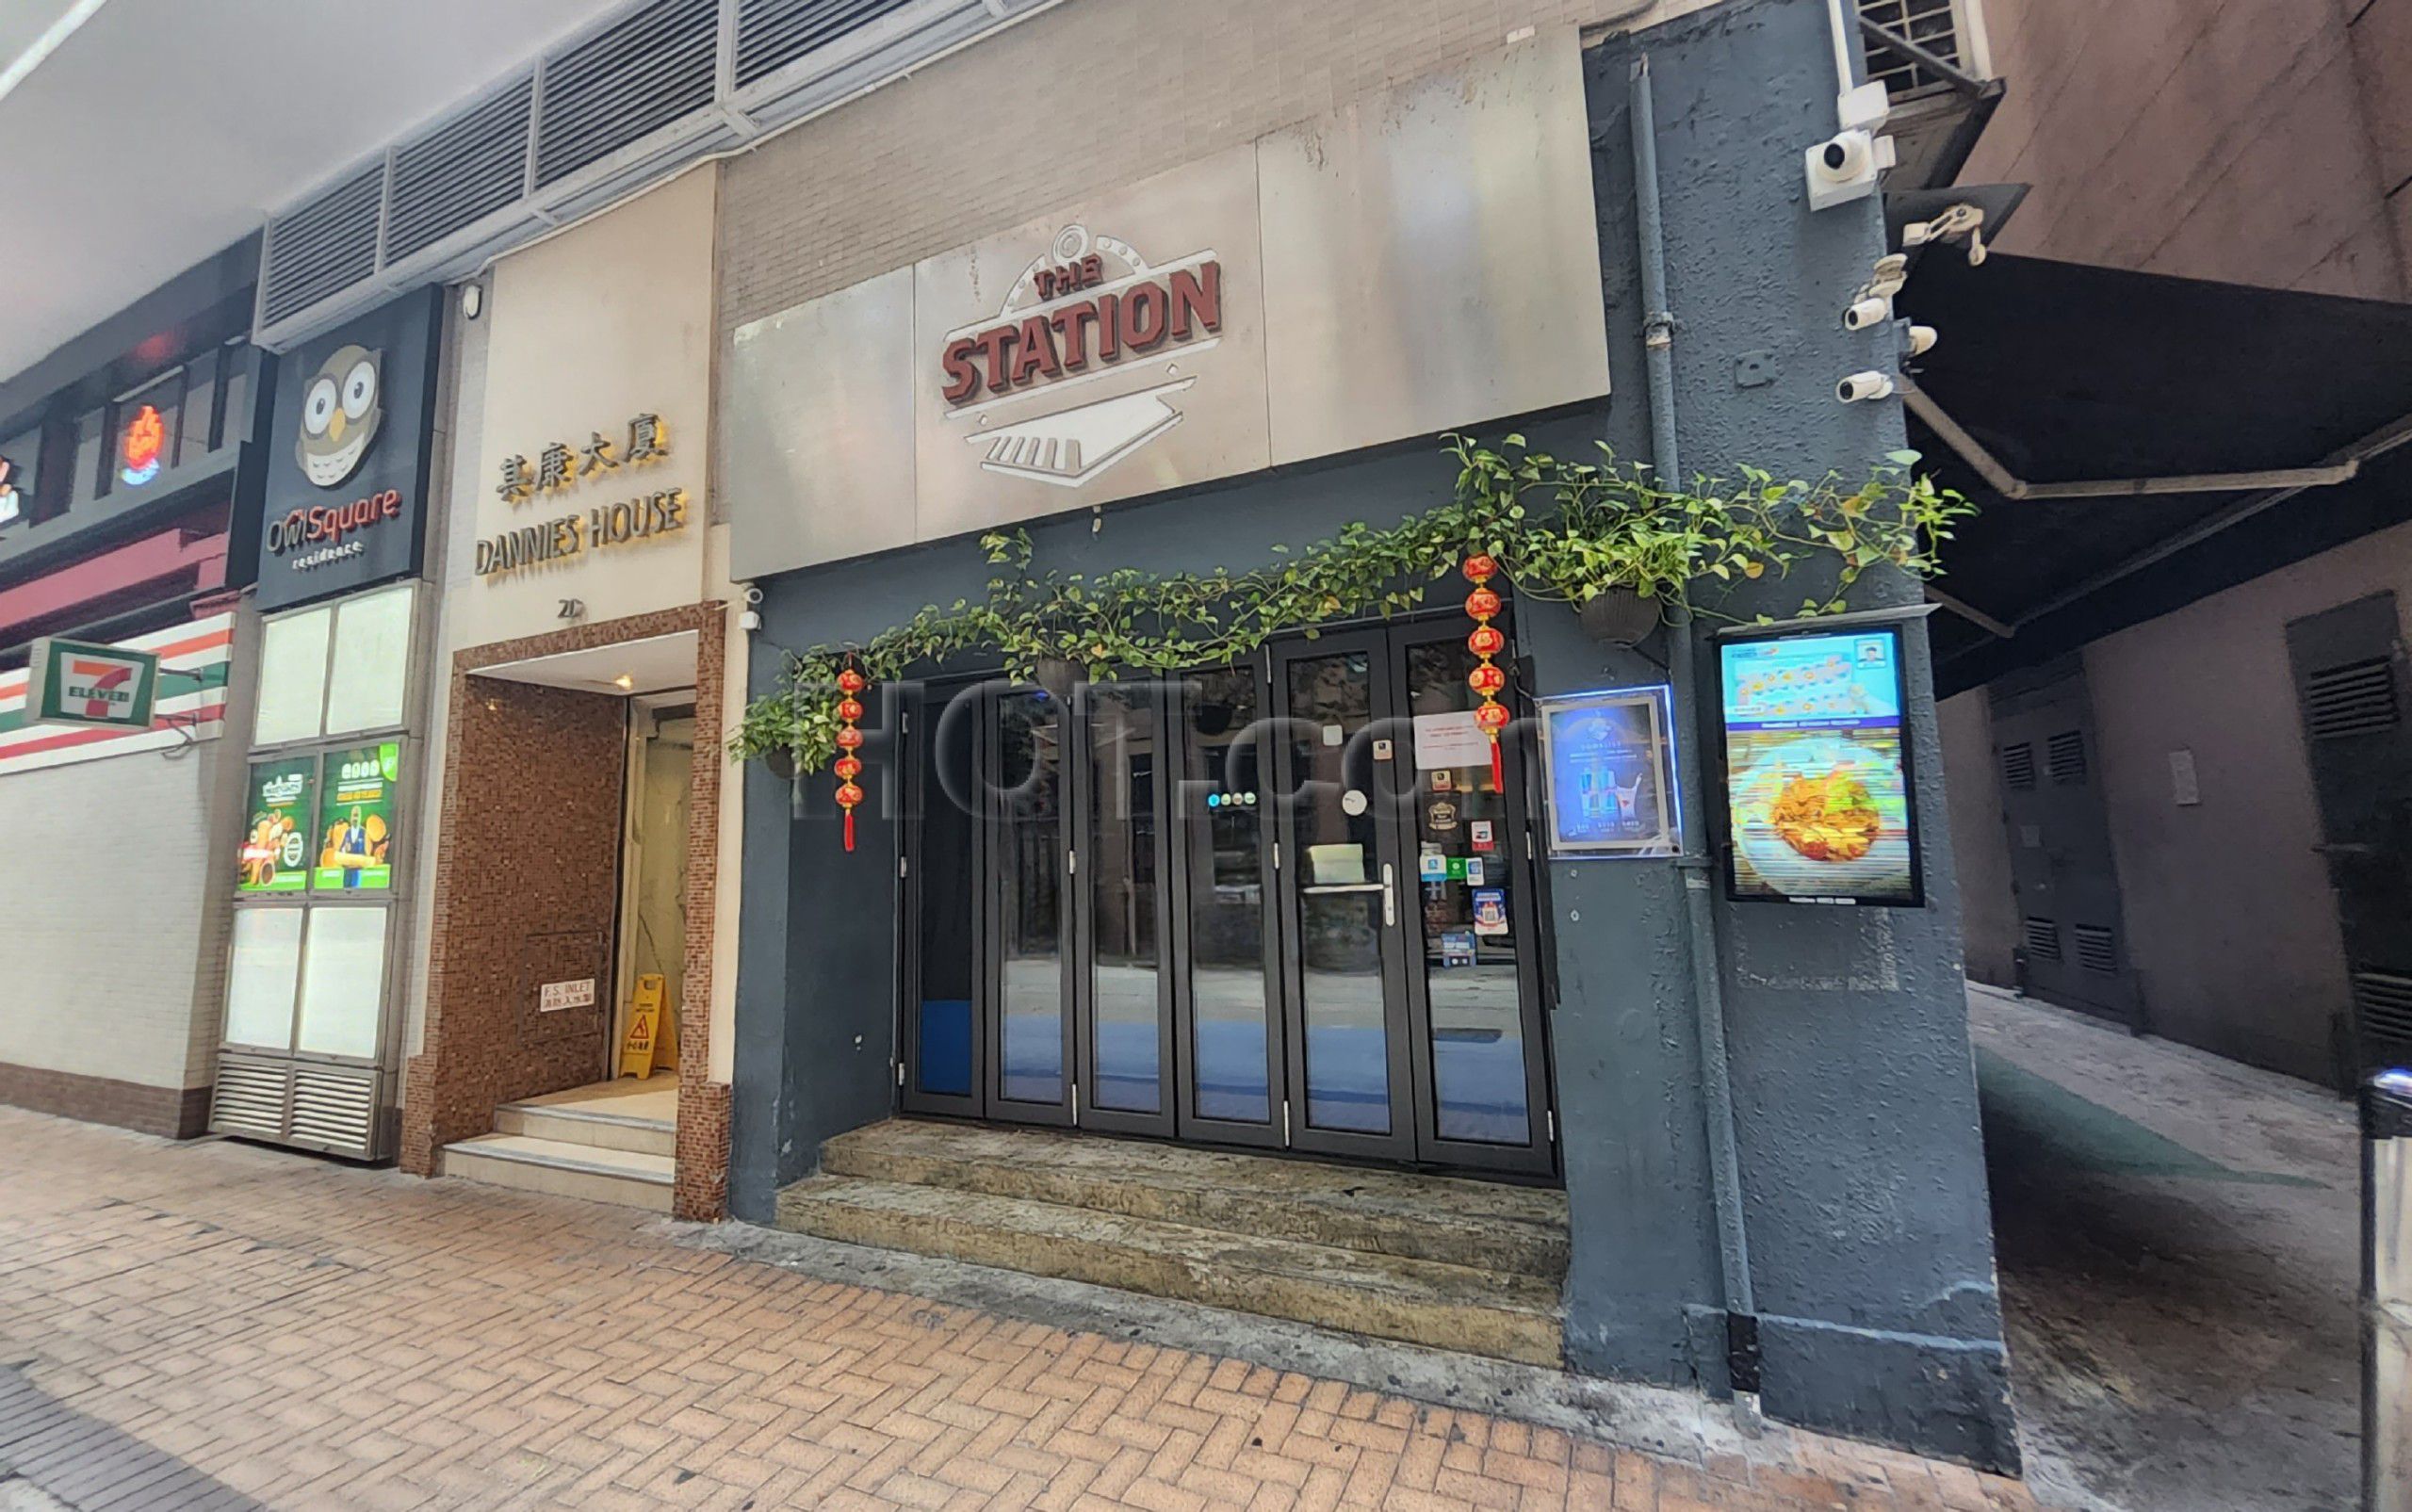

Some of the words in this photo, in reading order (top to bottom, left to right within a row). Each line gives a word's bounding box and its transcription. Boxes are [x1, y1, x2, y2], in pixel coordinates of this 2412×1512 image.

[1034, 252, 1104, 301] THE
[941, 259, 1223, 405] STATION
[292, 541, 365, 570] residence
[474, 514, 581, 577] DANNIES
[589, 487, 683, 548] HOUSE
[73, 659, 132, 718] 7
